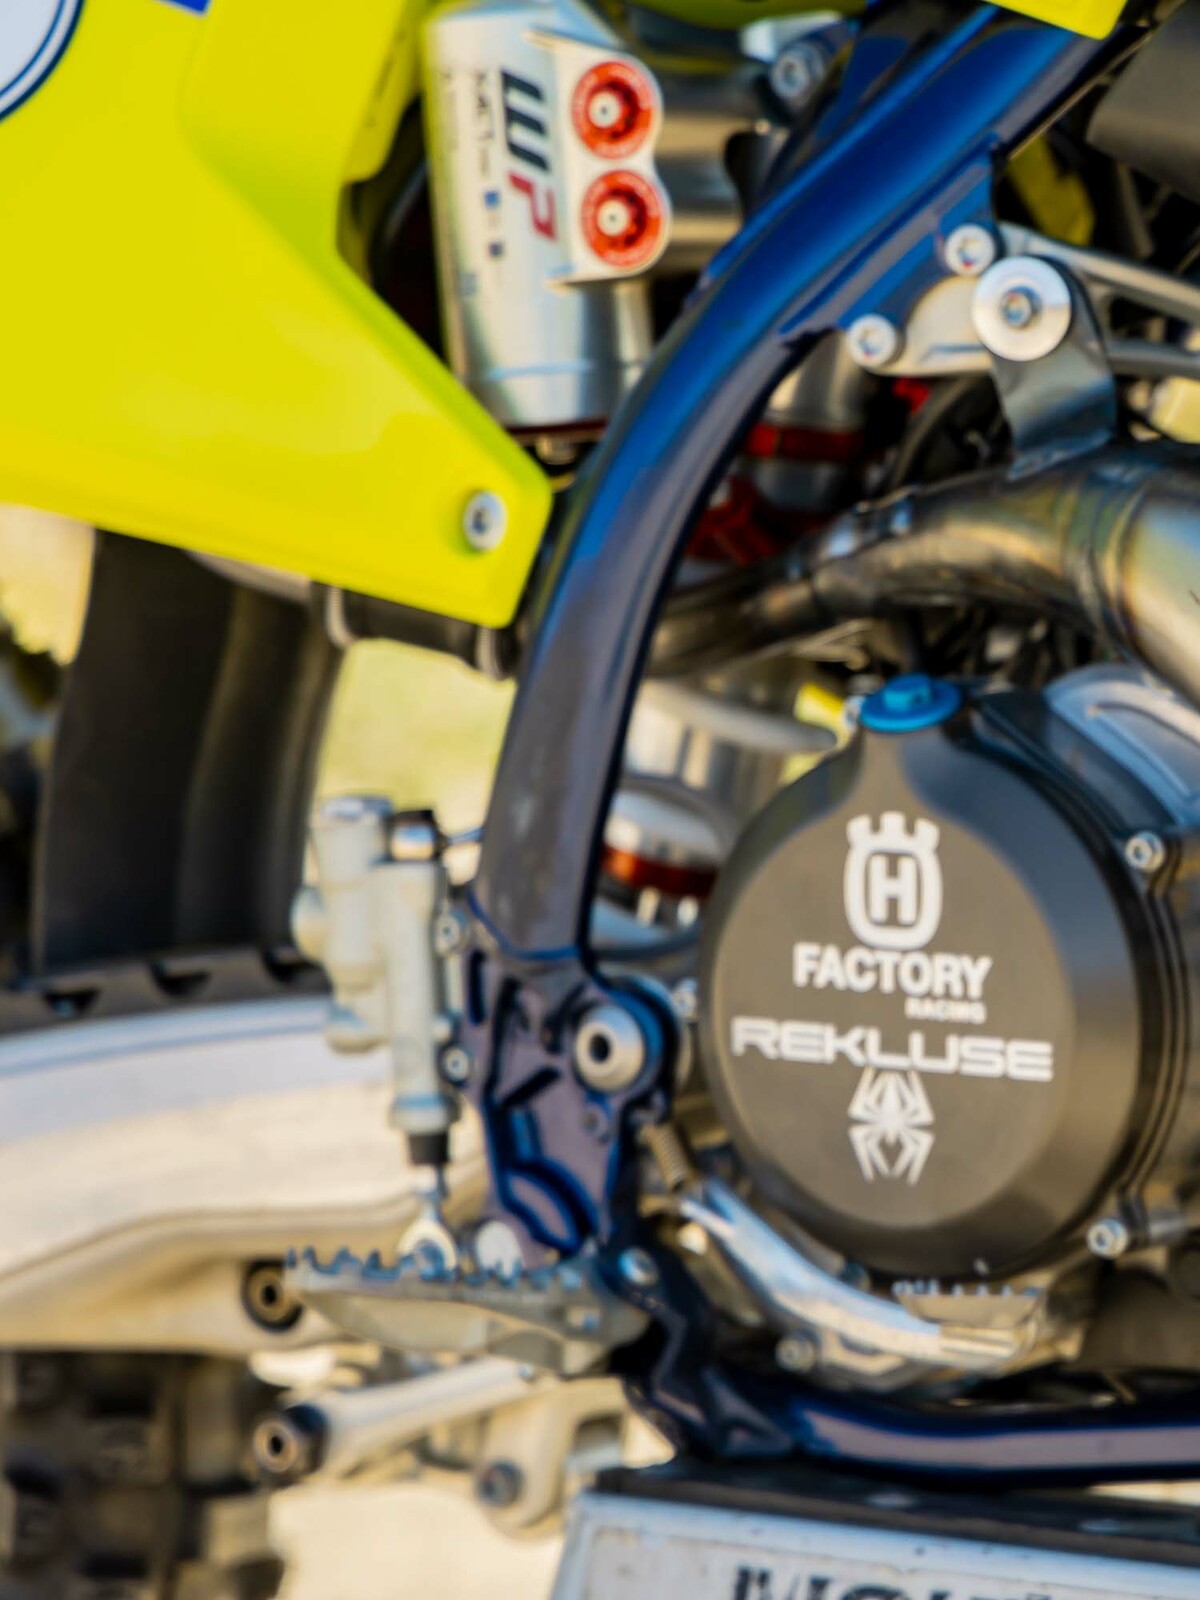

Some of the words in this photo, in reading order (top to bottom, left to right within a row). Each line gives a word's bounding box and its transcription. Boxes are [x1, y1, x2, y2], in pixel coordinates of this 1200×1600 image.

[500, 69, 556, 241] WP
[793, 941, 993, 1001] FACTORY
[905, 997, 987, 1024] RACING
[730, 1016, 1055, 1083] REKLUSE
